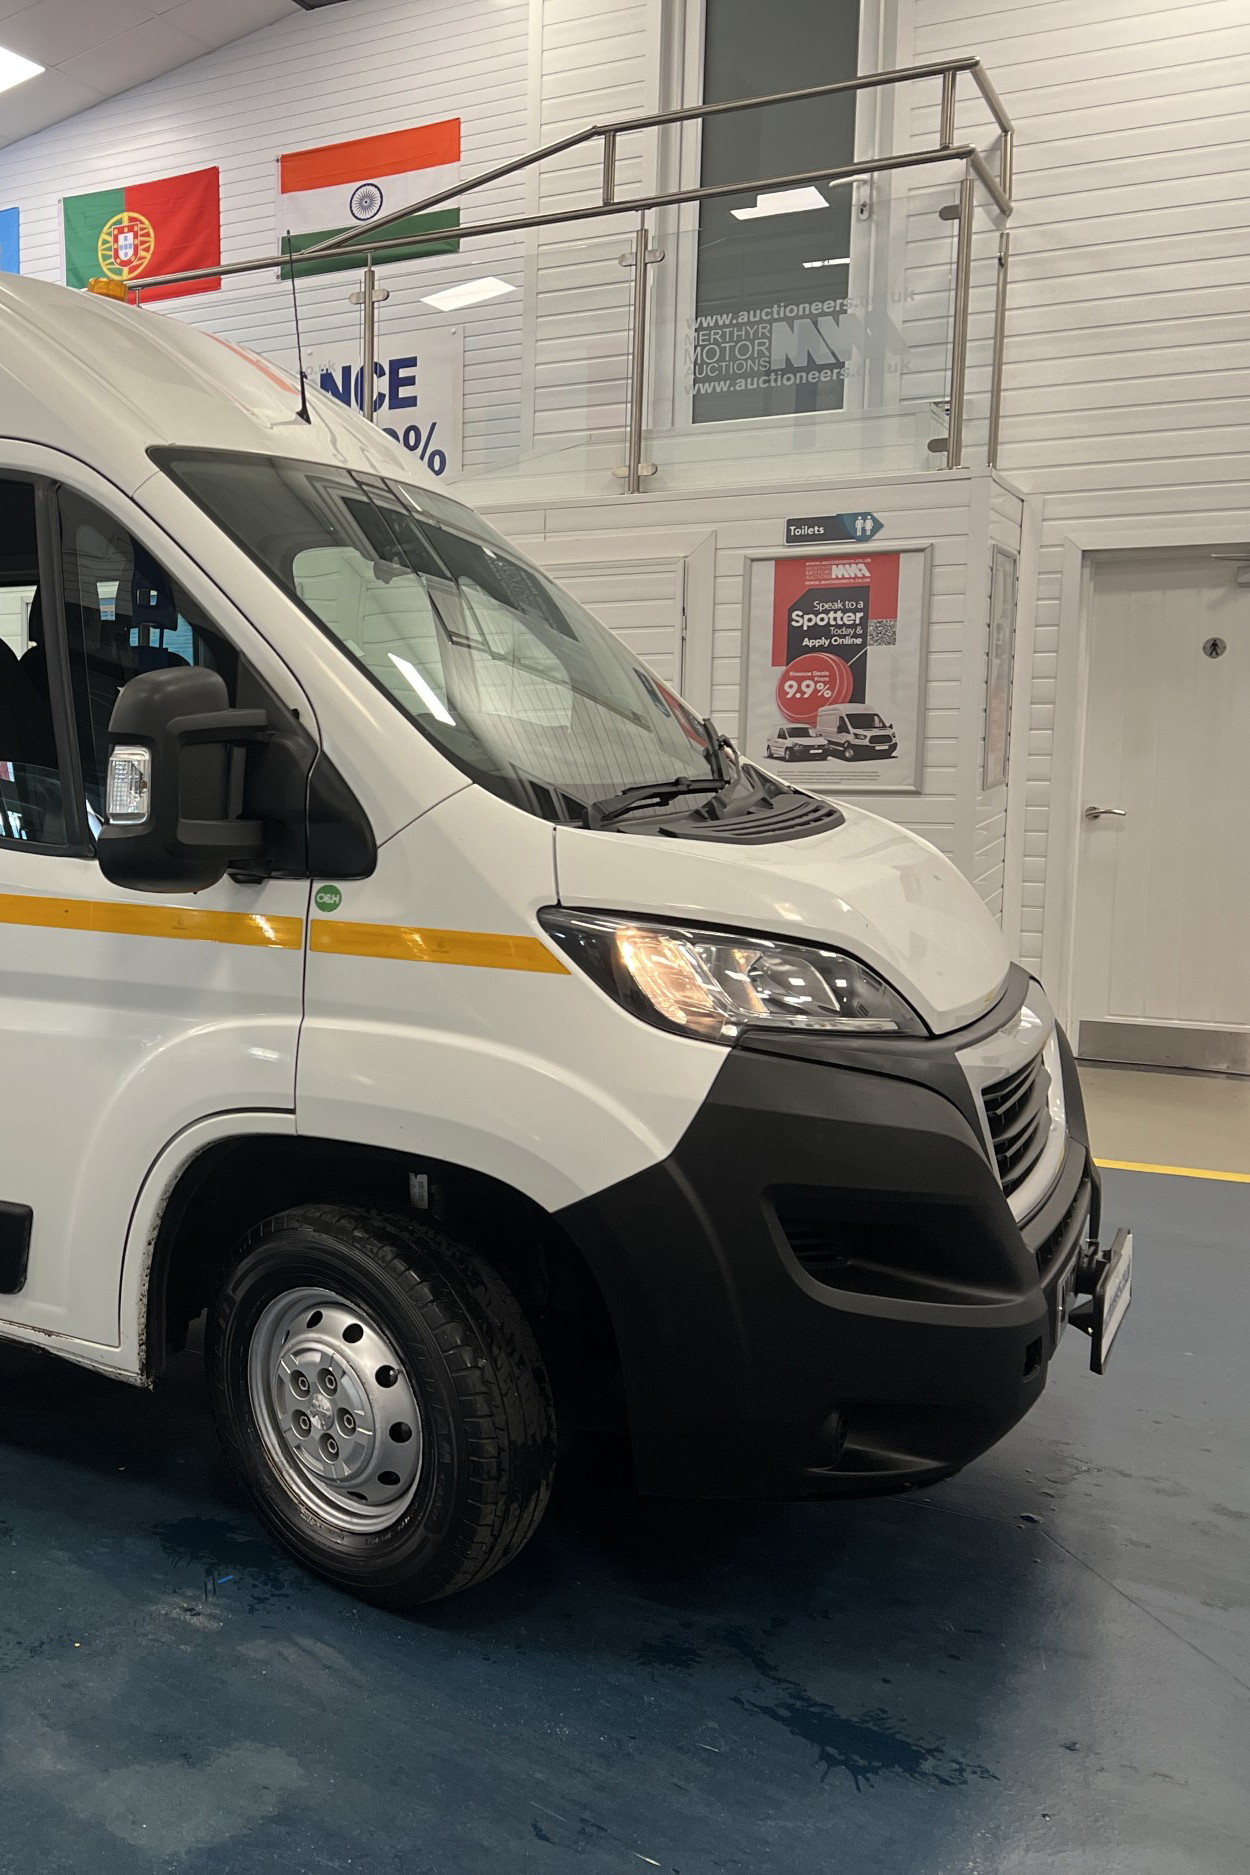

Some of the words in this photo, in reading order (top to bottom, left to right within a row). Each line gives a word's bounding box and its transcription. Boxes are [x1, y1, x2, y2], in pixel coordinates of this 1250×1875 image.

[686, 286, 916, 329] www.auctioneers.cuk
[684, 323, 771, 346] MERTHYR
[683, 338, 770, 365] MOTOR
[684, 358, 770, 380] AUCTIONS
[685, 359, 913, 396] www.auctioneers.cuk
[789, 525, 825, 536] Toilets
[813, 600, 845, 611] Speak
[845, 601, 856, 609] to
[791, 610, 864, 630] Spotter
[830, 626, 855, 637] Today
[856, 626, 863, 634] &
[802, 637, 830, 648] Apply
[831, 636, 863, 645] Online
[784, 680, 832, 698] 9.9%
[316, 892, 340, 904] O&H
